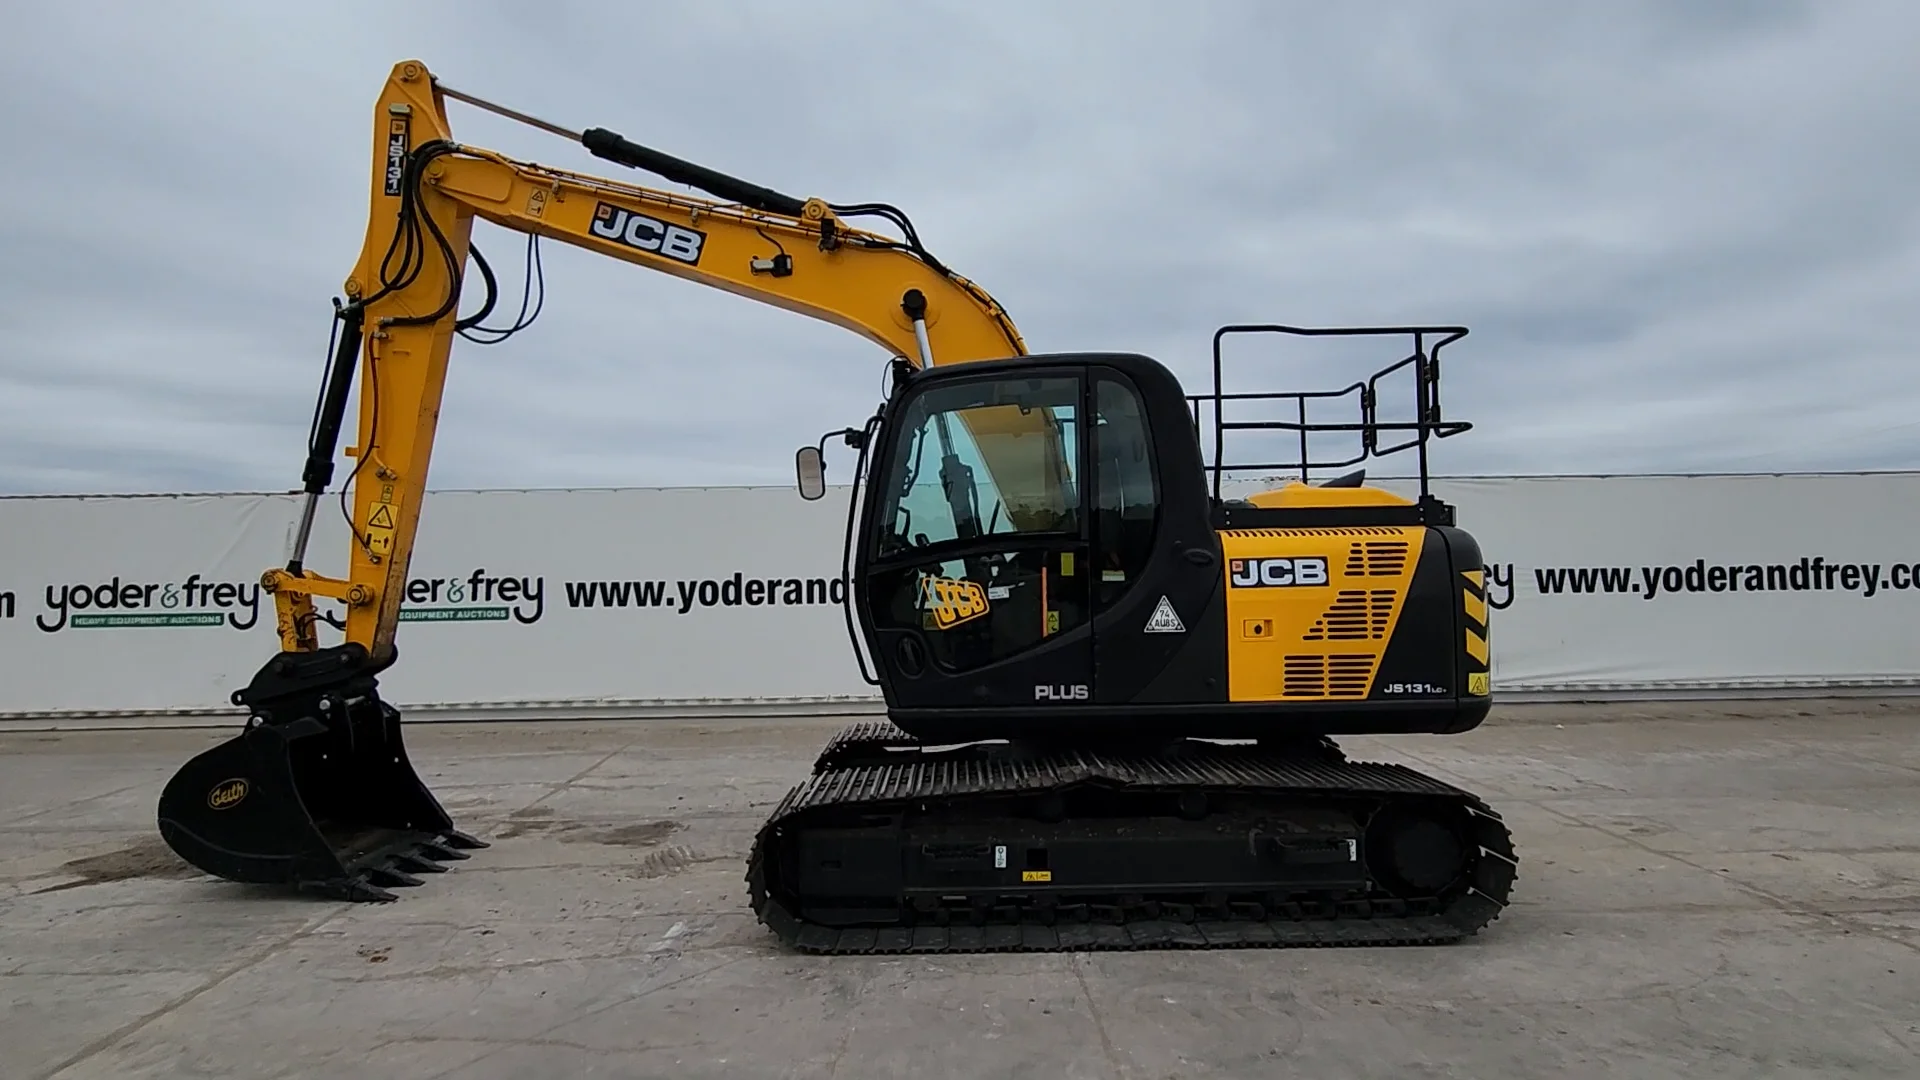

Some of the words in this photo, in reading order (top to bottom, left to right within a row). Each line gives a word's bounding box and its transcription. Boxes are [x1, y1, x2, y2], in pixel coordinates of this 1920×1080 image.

[593, 210, 702, 262] JCB
[1232, 559, 1327, 586] JCB
[565, 573, 855, 614] www.yoderand
[935, 583, 985, 622] JCB
[75, 616, 106, 625] HEAVY
[109, 615, 167, 625] EQUIPMENT
[171, 614, 222, 624] AUCTIONS
[399, 610, 455, 620] EQUIPMENT
[456, 609, 507, 618] AUCTIONS
[1034, 685, 1089, 700] PLUS
